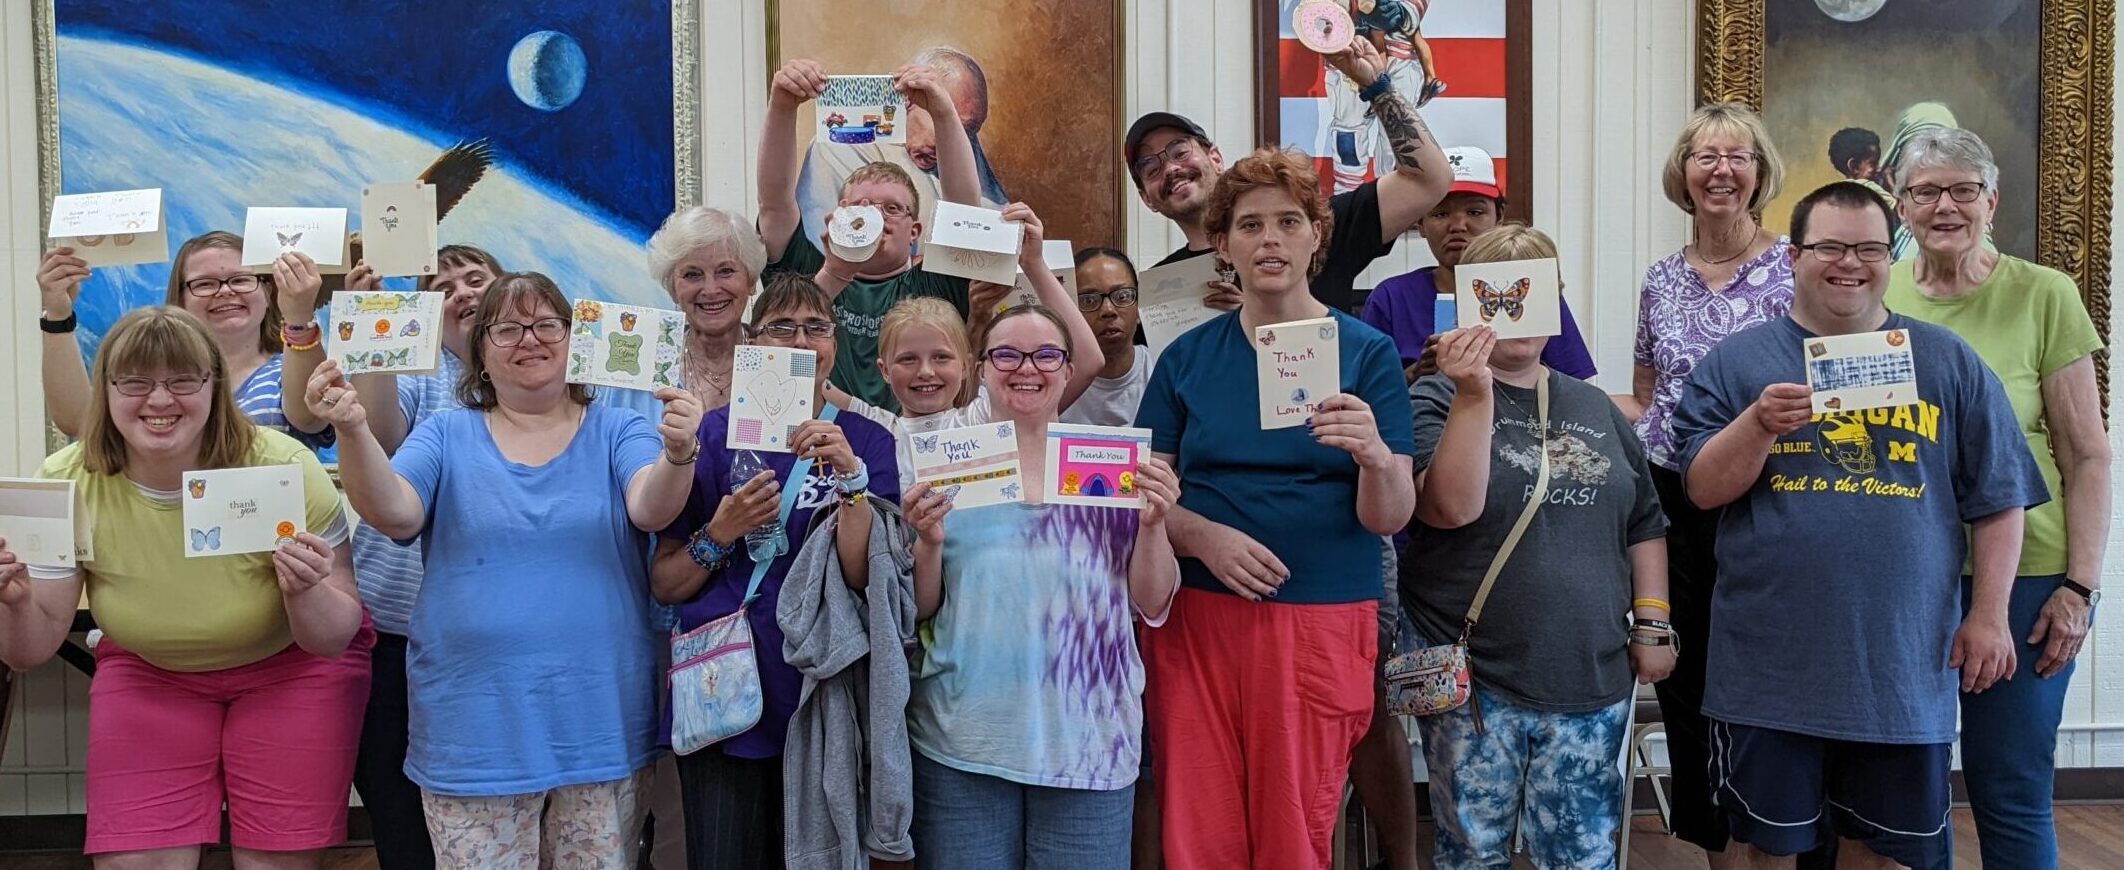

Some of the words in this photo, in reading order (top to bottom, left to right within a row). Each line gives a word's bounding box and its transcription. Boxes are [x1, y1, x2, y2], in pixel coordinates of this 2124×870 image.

[1272, 347, 1315, 363] Thank
[1277, 367, 1298, 378] You
[1276, 405, 1301, 416] Love
[1561, 420, 1607, 439] Island
[940, 439, 981, 455] Thank
[1888, 440, 1918, 463] M
[1075, 450, 1105, 460] Thank
[1106, 451, 1126, 461] You
[1770, 474, 1808, 493] Hail
[1812, 476, 1829, 491] to
[1834, 475, 1859, 494] the
[1861, 477, 1926, 499] Victors!
[229, 499, 257, 510] thank
[237, 507, 257, 520] you
